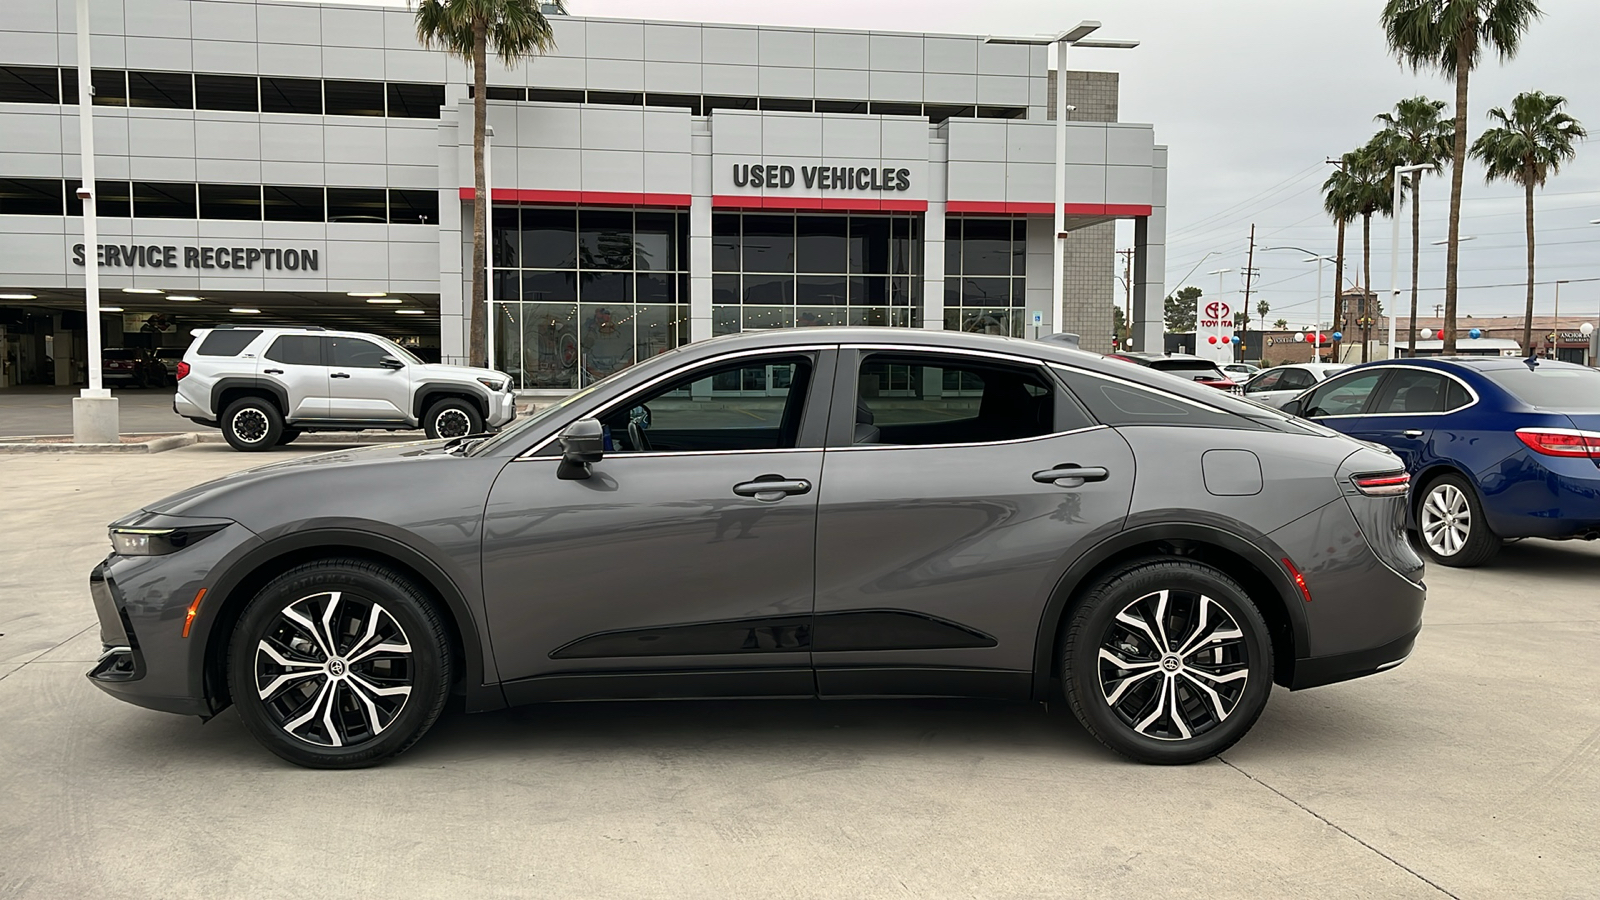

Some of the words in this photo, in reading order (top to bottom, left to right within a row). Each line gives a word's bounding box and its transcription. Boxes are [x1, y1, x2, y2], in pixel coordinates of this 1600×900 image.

[733, 164, 795, 188] USED
[802, 166, 910, 191] VEHICLES
[184, 246, 318, 271] RECEPTION
